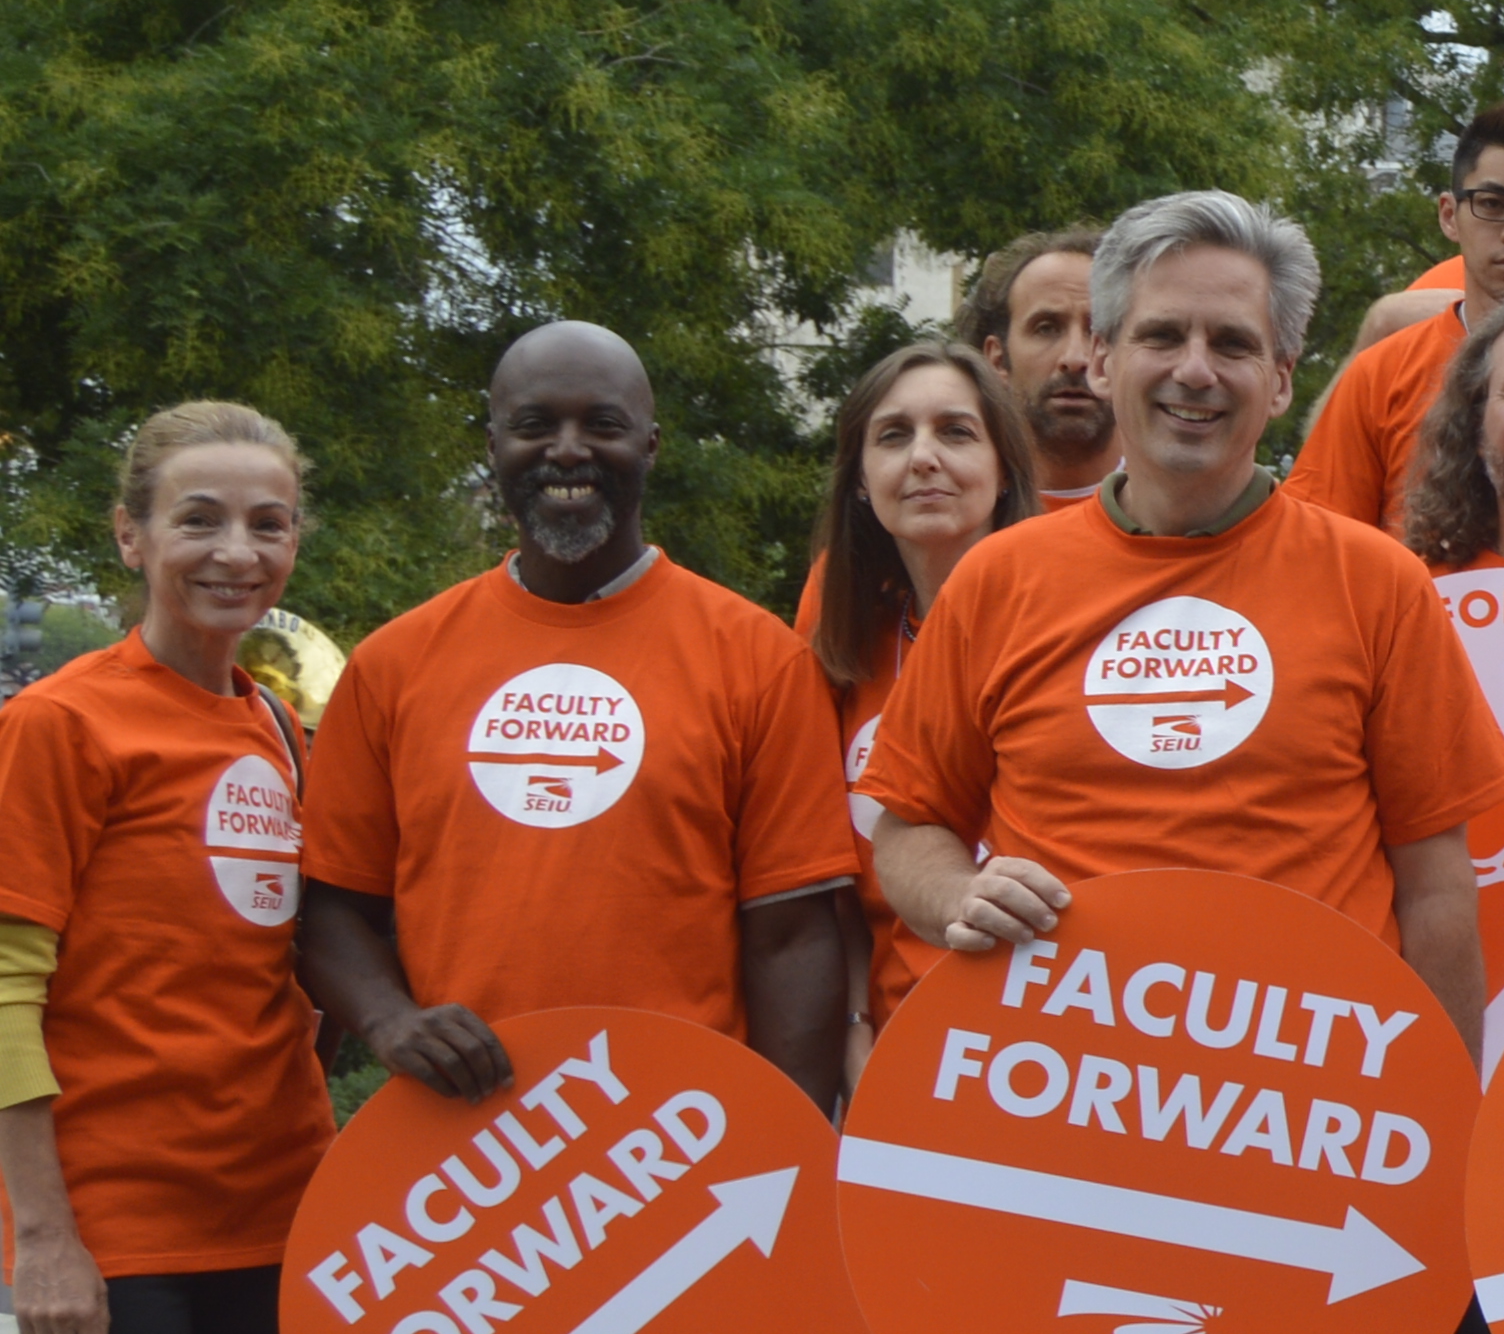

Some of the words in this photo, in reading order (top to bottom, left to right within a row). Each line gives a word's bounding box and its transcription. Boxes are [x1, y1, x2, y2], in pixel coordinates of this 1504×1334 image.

[1116, 627, 1246, 652] FACULTY
[1100, 654, 1258, 680] FORWARD
[502, 693, 624, 716] FACULTY
[485, 719, 630, 742] FORWARD
[1150, 737, 1201, 753] SEIU
[524, 798, 572, 812] SEIU
[252, 896, 283, 910] SEIU
[1001, 939, 1419, 1078] FACULTY
[933, 1028, 1431, 1185] FORWARD
[307, 1029, 630, 1325] FACULTY
